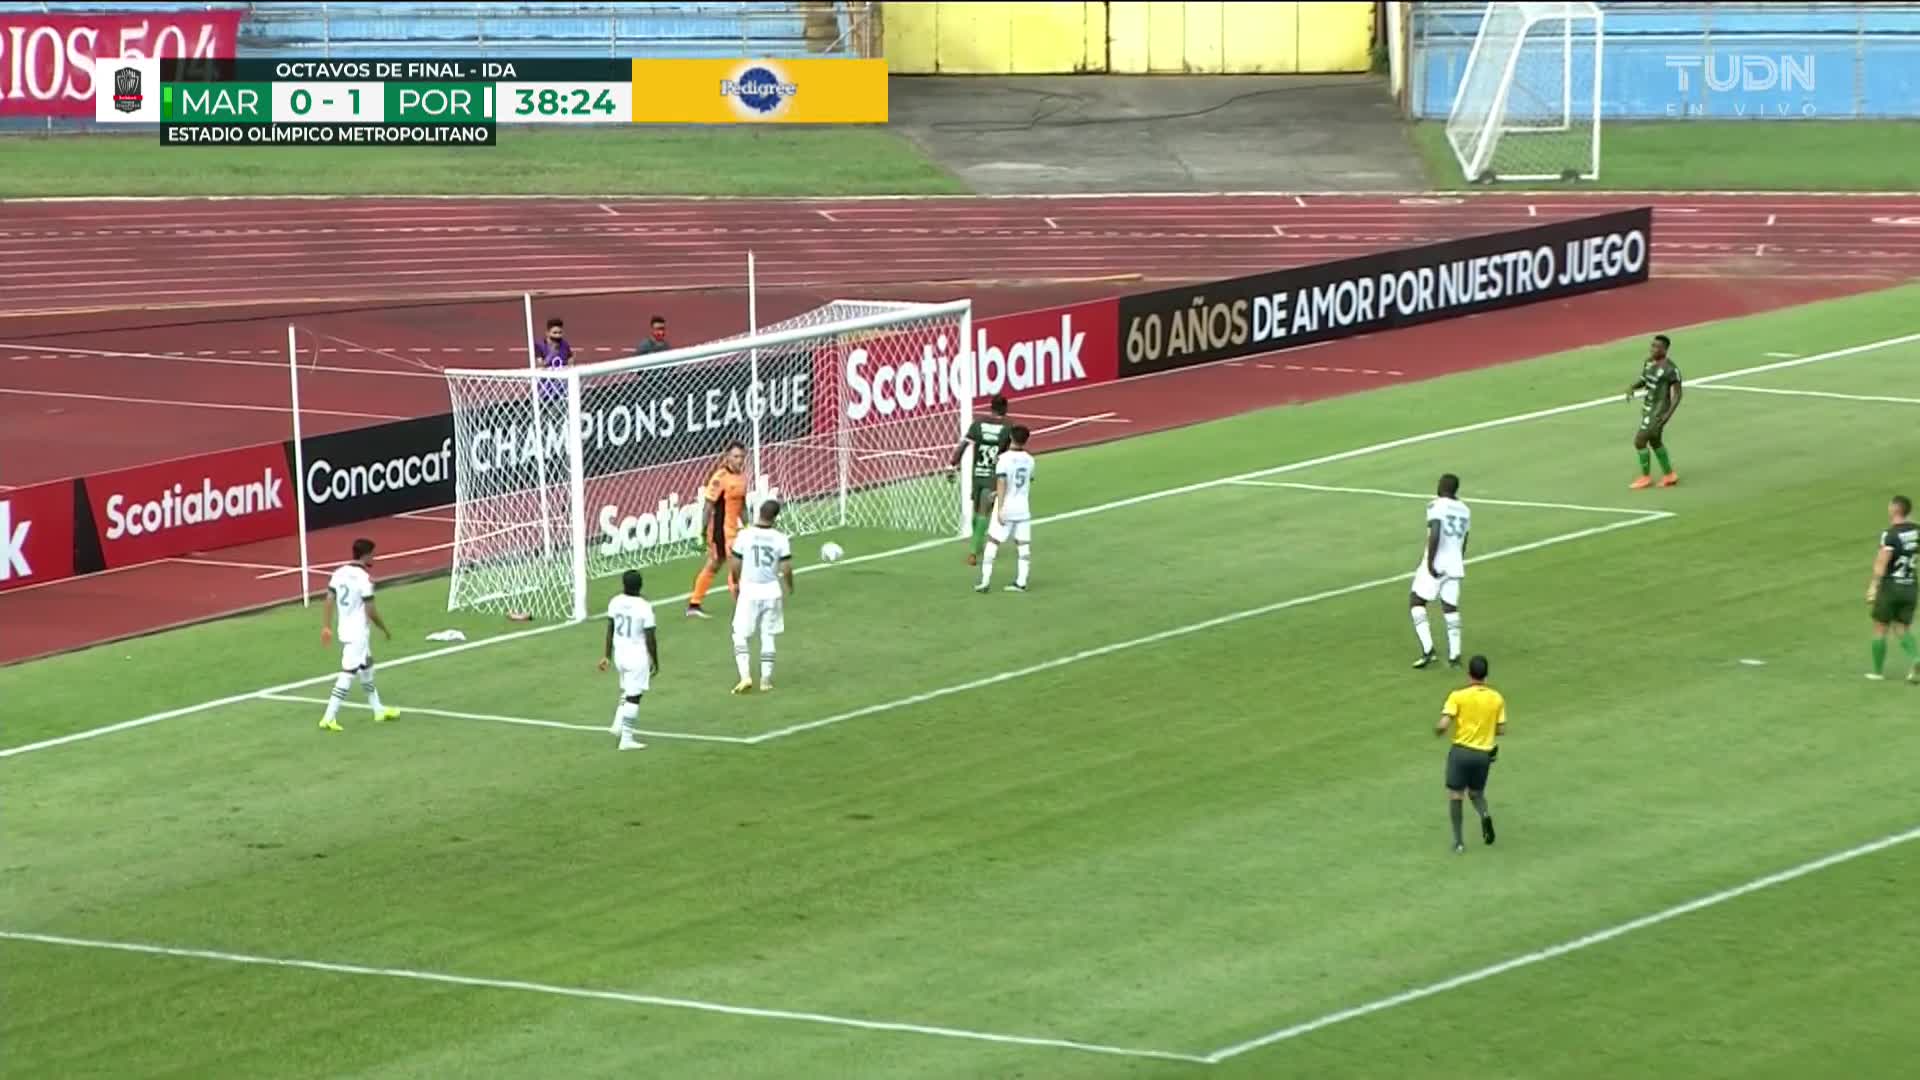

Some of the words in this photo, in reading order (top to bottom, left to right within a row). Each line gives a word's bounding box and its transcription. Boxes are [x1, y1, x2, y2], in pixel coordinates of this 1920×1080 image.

[0, 26, 98, 100] IOS
[1126, 313, 1162, 363] 60
[1167, 296, 1249, 357] AÑOS
[1253, 292, 1287, 342] DE
[1291, 277, 1375, 334] AMOR
[1378, 266, 1436, 317] POR
[1437, 245, 1556, 308] NUESTRO
[1558, 229, 1645, 285] JUEGO
[846, 313, 1087, 420] Scotiabank
[686, 374, 809, 433] LEAGUE
[307, 438, 452, 503] Concacaf
[1015, 467, 1027, 488] 5
[105, 467, 283, 540] Scotiabank
[1443, 514, 1467, 539] 33
[751, 544, 775, 568] 13
[339, 583, 350, 607] 2
[615, 612, 632, 638] 21
